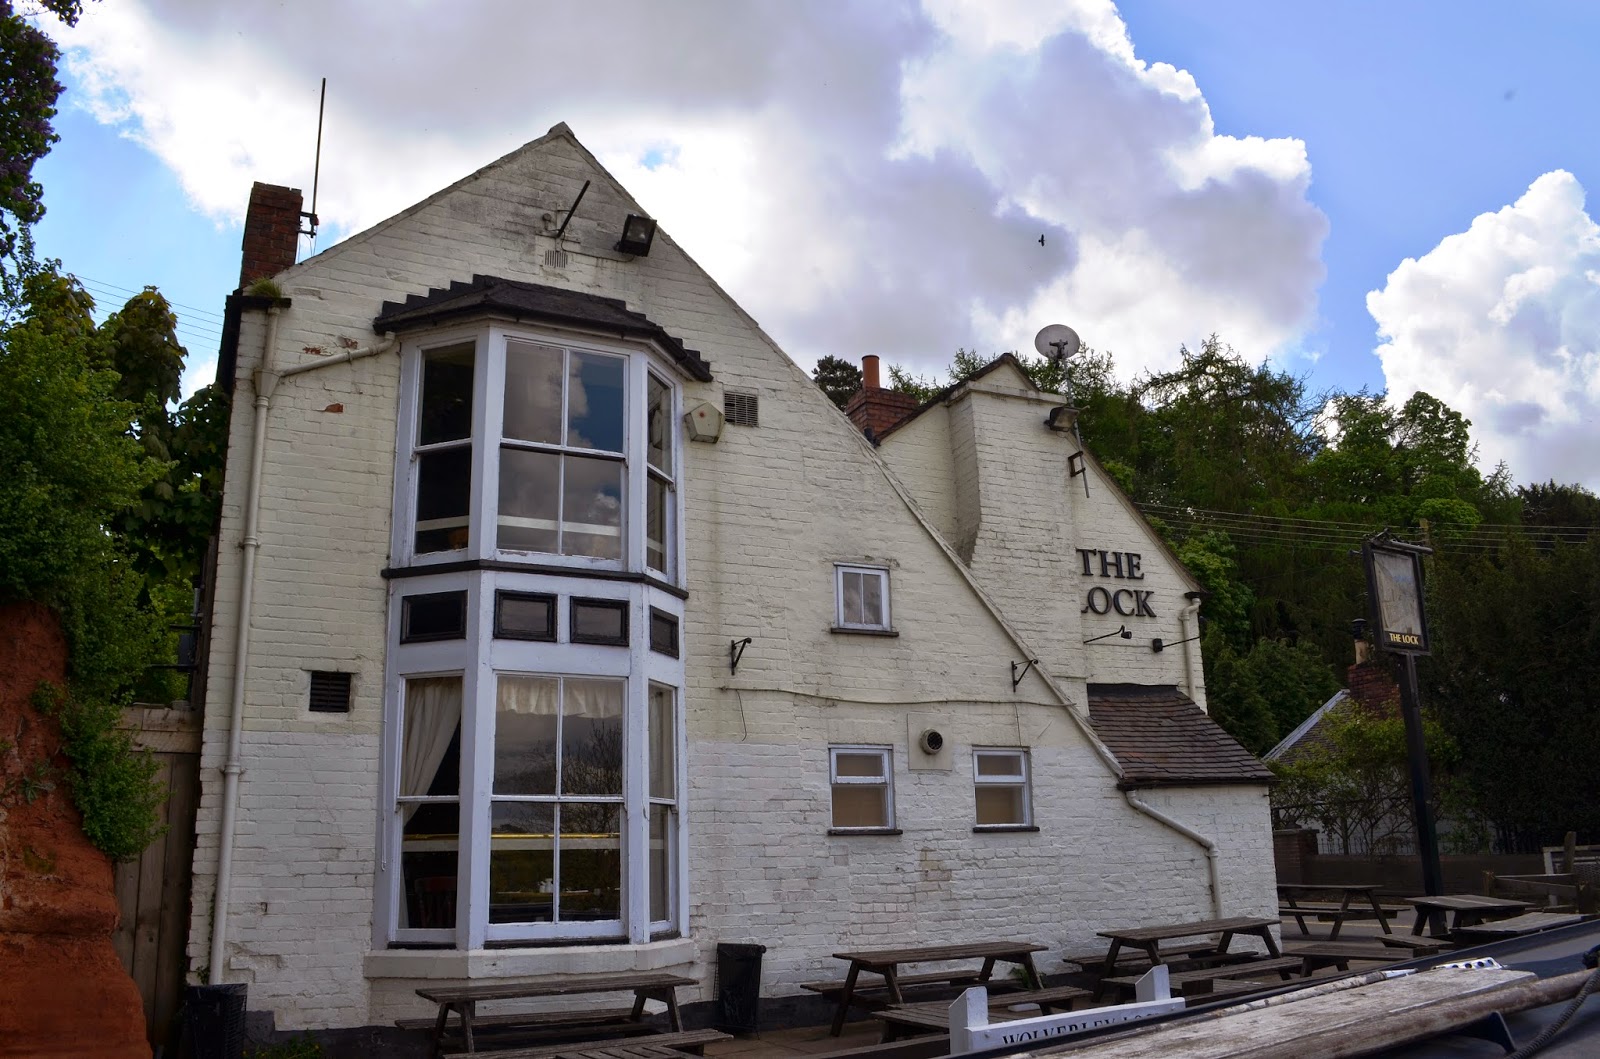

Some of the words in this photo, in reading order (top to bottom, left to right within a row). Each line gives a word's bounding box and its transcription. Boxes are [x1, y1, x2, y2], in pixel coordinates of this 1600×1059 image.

[1075, 547, 1144, 580] THE
[1080, 586, 1157, 618] OCK
[1389, 632, 1402, 643] THE
[1402, 634, 1419, 645] LOCK
